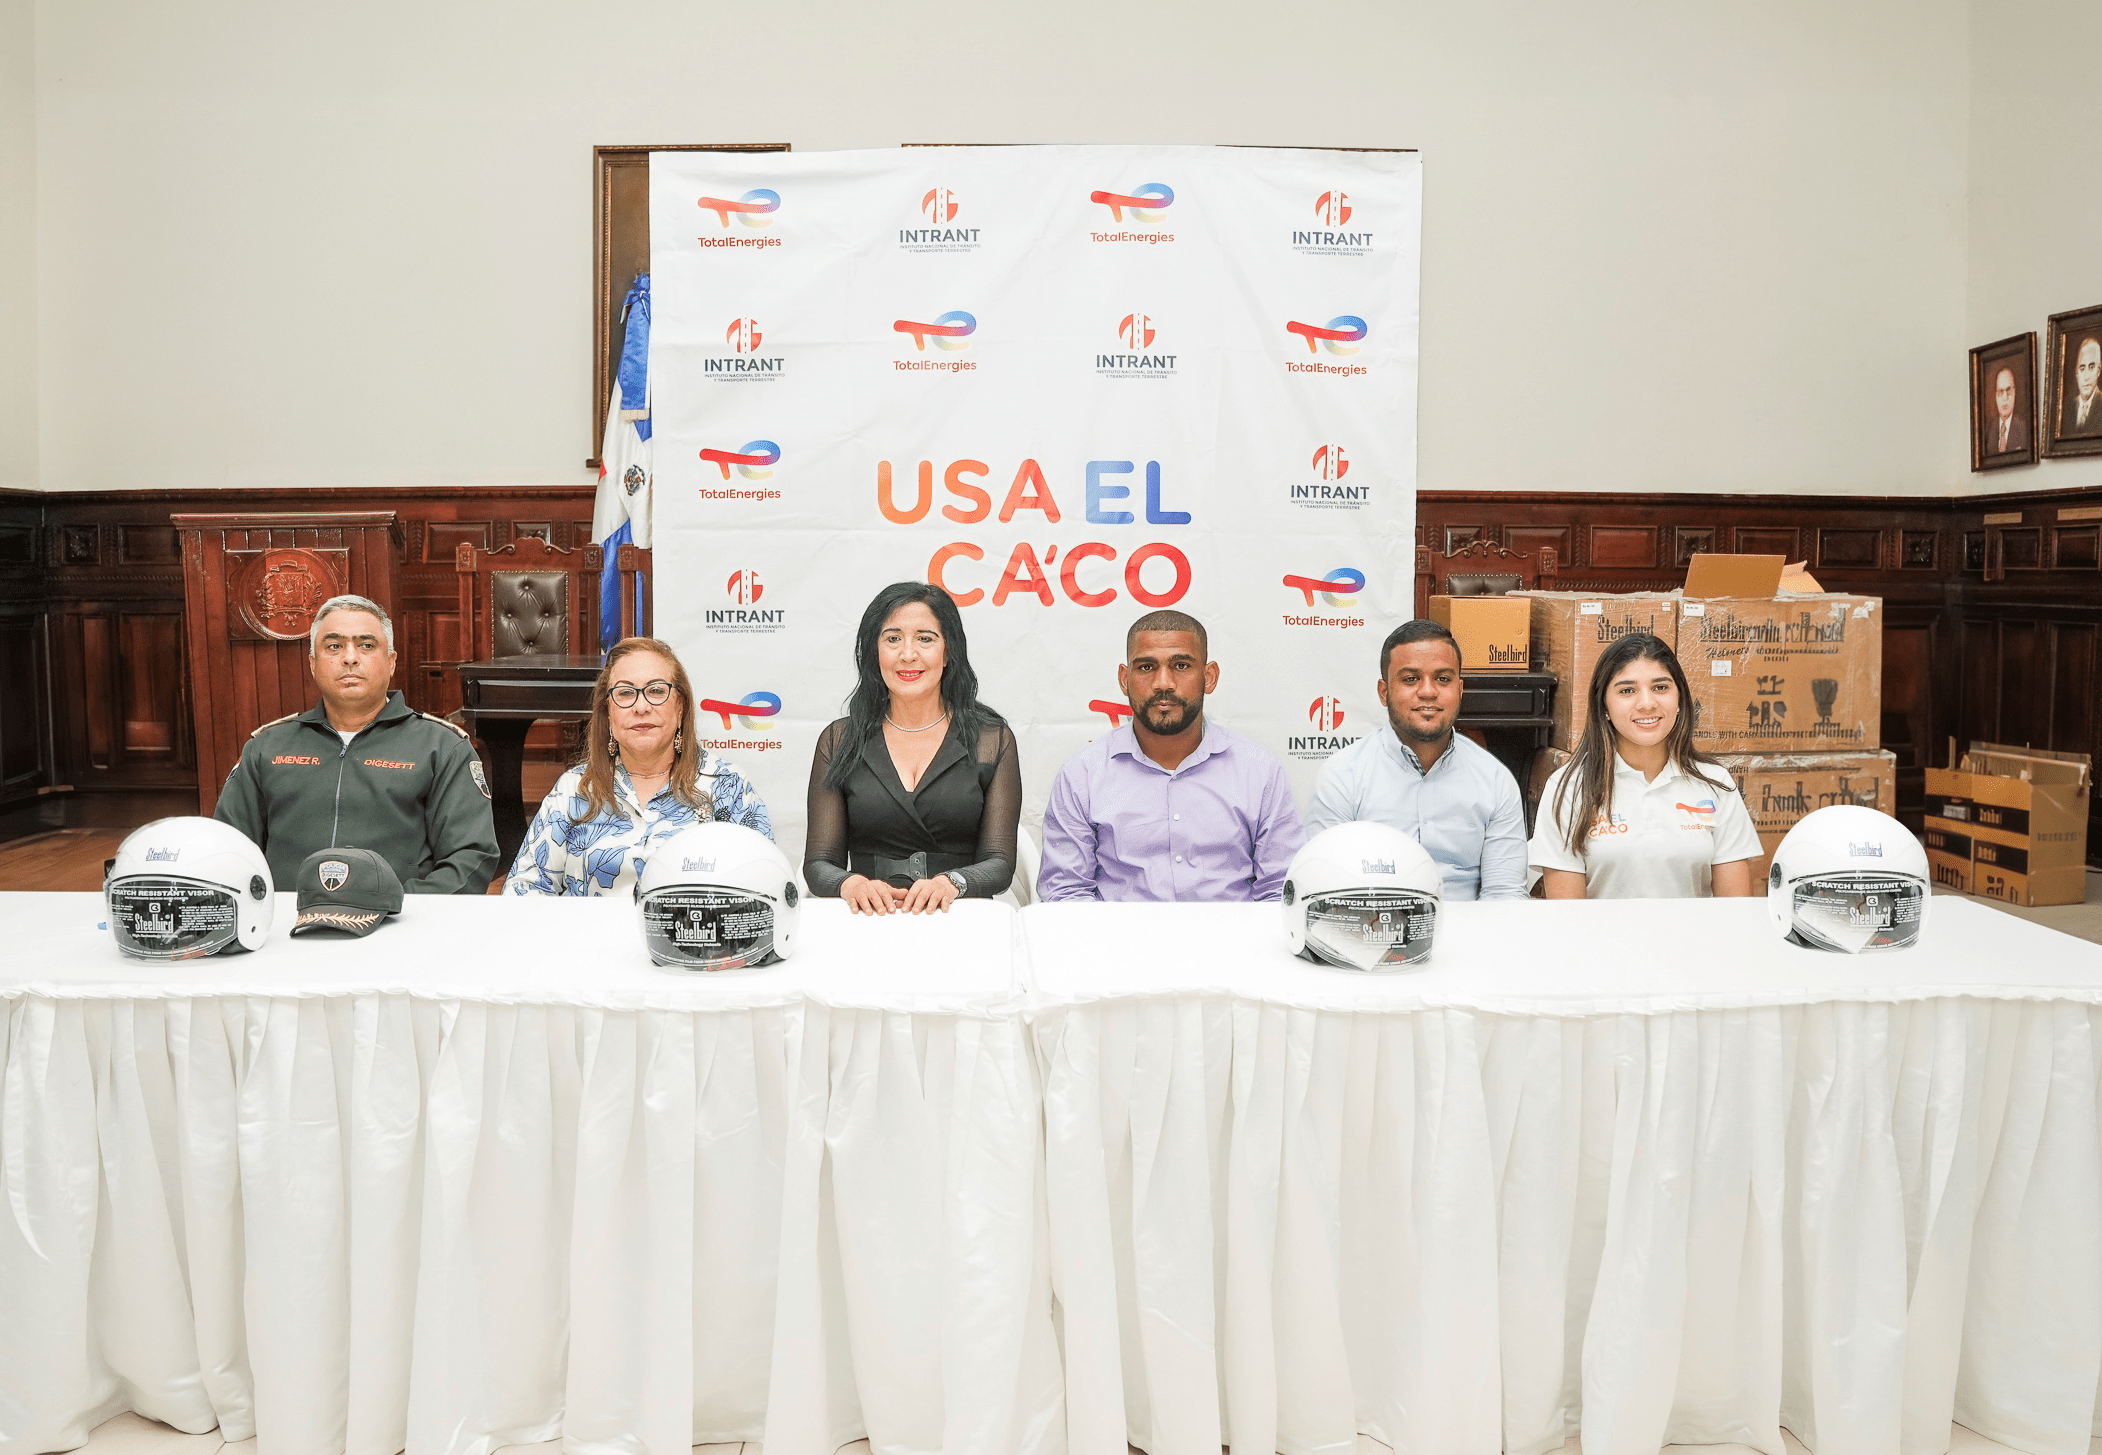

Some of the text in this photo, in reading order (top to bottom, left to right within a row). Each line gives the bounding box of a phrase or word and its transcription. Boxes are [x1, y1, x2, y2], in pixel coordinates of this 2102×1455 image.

[698, 236, 781, 250] TotalEnergies
[899, 228, 980, 243] INTRANT
[1090, 231, 1174, 245] TotalEnergies
[1293, 231, 1373, 246] INTRANT
[704, 358, 784, 372] INTRANT
[893, 359, 976, 373] TotalEnergies
[1096, 354, 1177, 369] INTRANT
[1286, 361, 1367, 377] TotalEnergies
[699, 488, 781, 502] TotalEnergies
[877, 458, 1192, 525] USA EL
[1291, 484, 1370, 500] INTRANT
[705, 609, 785, 624] INTRANT
[1283, 615, 1365, 629] TotalEnergies
[1488, 644, 1527, 662] Steelbird
[700, 739, 782, 752] TotalEnergies
[272, 756, 321, 765] JIMENEZ R.
[364, 759, 415, 770] DIGESETT
[146, 847, 180, 862] Steelbird
[1849, 842, 1883, 857] Steelbird
[682, 857, 716, 872] Steelbird
[1361, 858, 1396, 874] Steelbird
[1811, 881, 1852, 890] SCRATCH
[1853, 882, 1899, 890] RESISTANT
[1324, 898, 1364, 907] SCRATCH
[1366, 899, 1411, 908] RESISTANT
[135, 912, 174, 933] Steelbird
[1849, 906, 1891, 927] Steelbird
[675, 921, 716, 942] Steelbird
[1362, 923, 1404, 944] Steelbird
